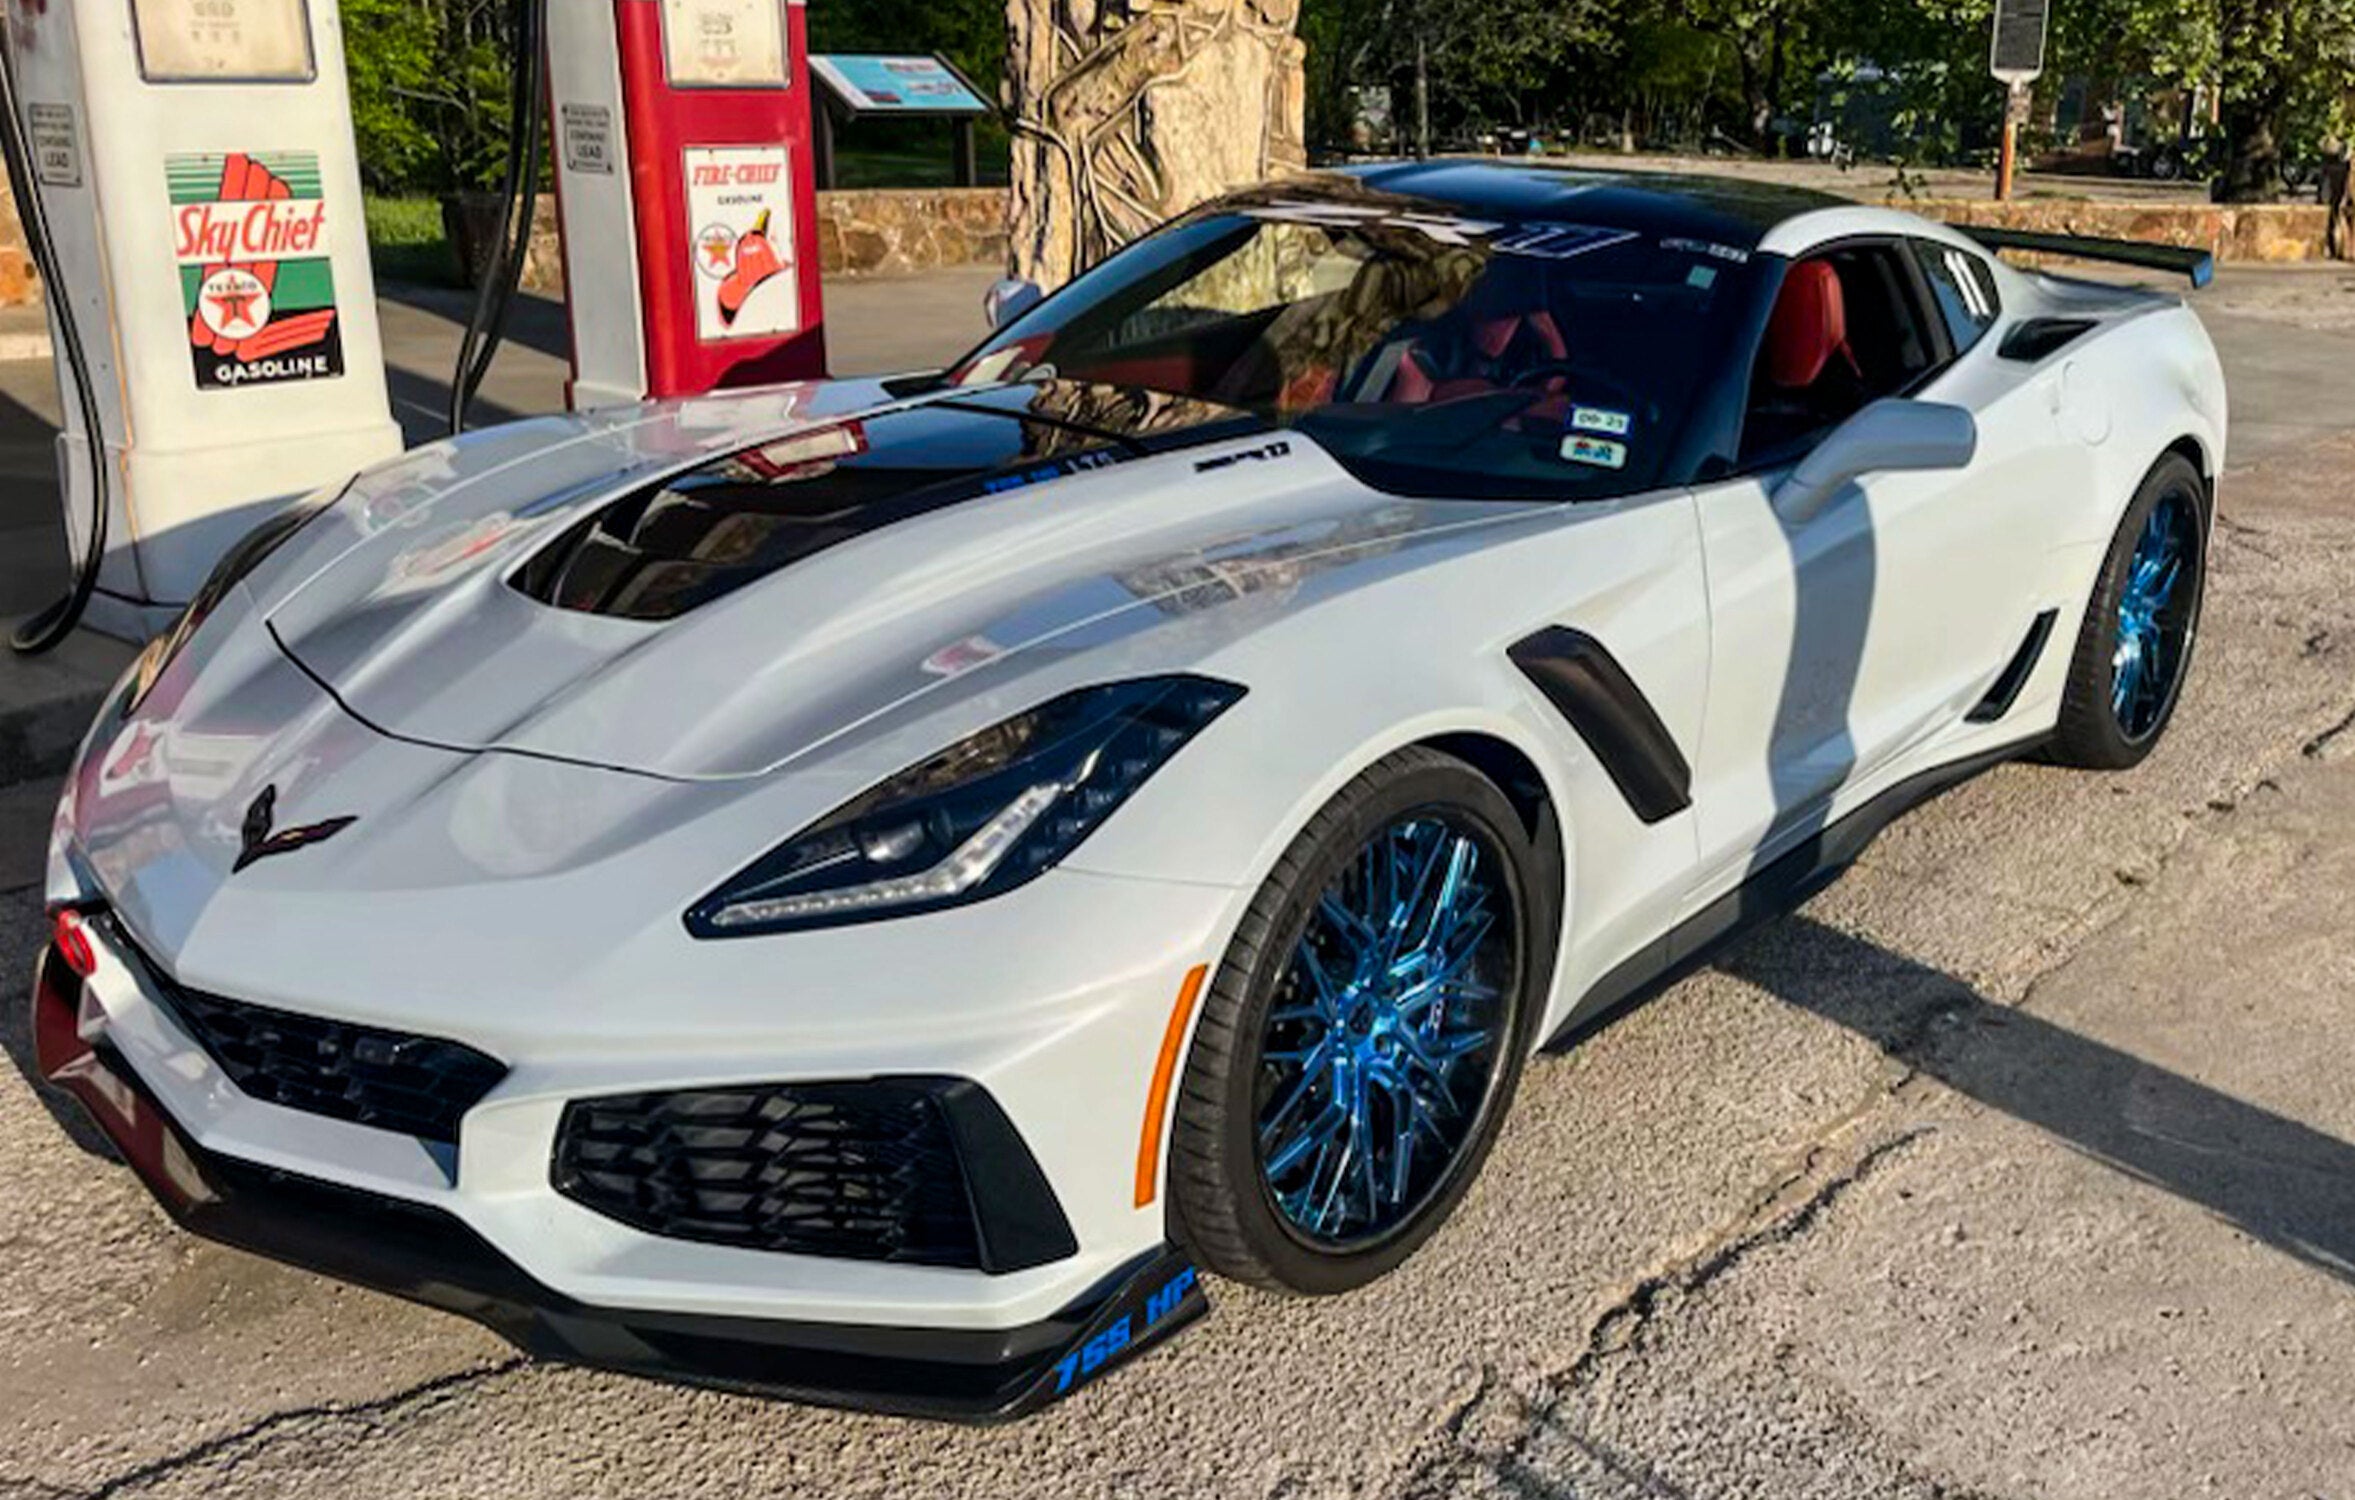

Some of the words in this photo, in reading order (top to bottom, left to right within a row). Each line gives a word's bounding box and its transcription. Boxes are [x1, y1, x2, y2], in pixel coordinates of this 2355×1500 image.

[45, 151, 70, 168] LEAD
[575, 144, 603, 159] LEAD
[693, 163, 782, 187] FIRE-CHIEF
[176, 205, 238, 265] Sky
[241, 201, 326, 254] Chief
[208, 281, 259, 292] TEXACO
[215, 355, 329, 384] GASOLINE
[1146, 1265, 1196, 1325] HP
